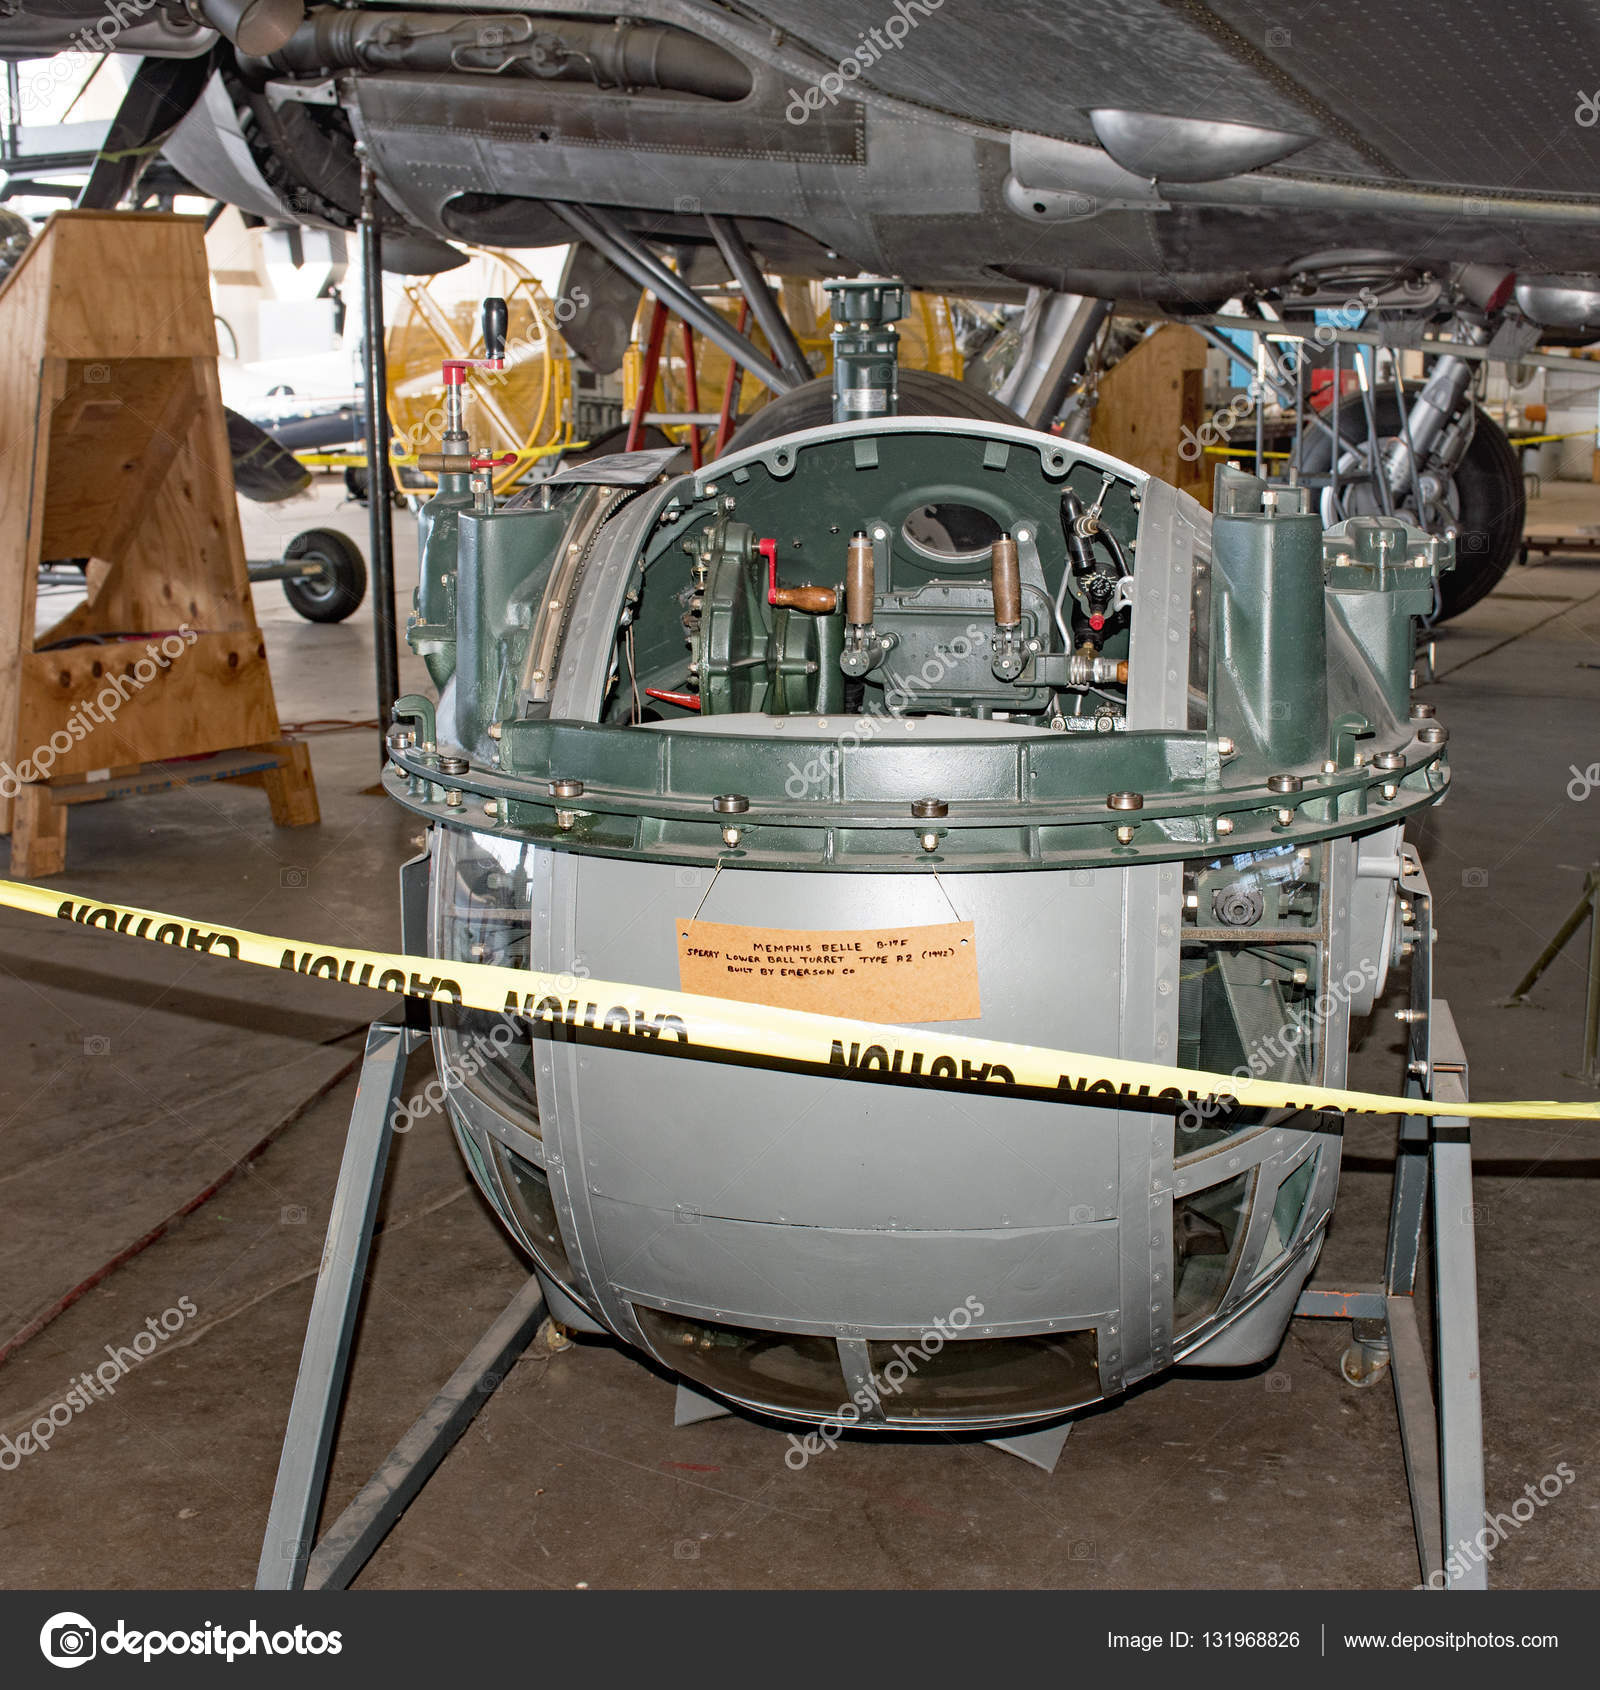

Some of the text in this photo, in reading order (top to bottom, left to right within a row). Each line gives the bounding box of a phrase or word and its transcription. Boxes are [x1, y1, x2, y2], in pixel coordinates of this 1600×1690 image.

[753, 943, 812, 953] MEMPHIS
[821, 943, 862, 953] BELLE
[686, 948, 719, 959] SPERRY
[726, 953, 761, 963] LOWER
[767, 955, 795, 964] BALL
[799, 955, 845, 964] TURRET
[859, 954, 889, 964] TYPE
[727, 965, 753, 973] BUILT
[760, 968, 775, 976] BY
[781, 968, 835, 977] EMERSON
